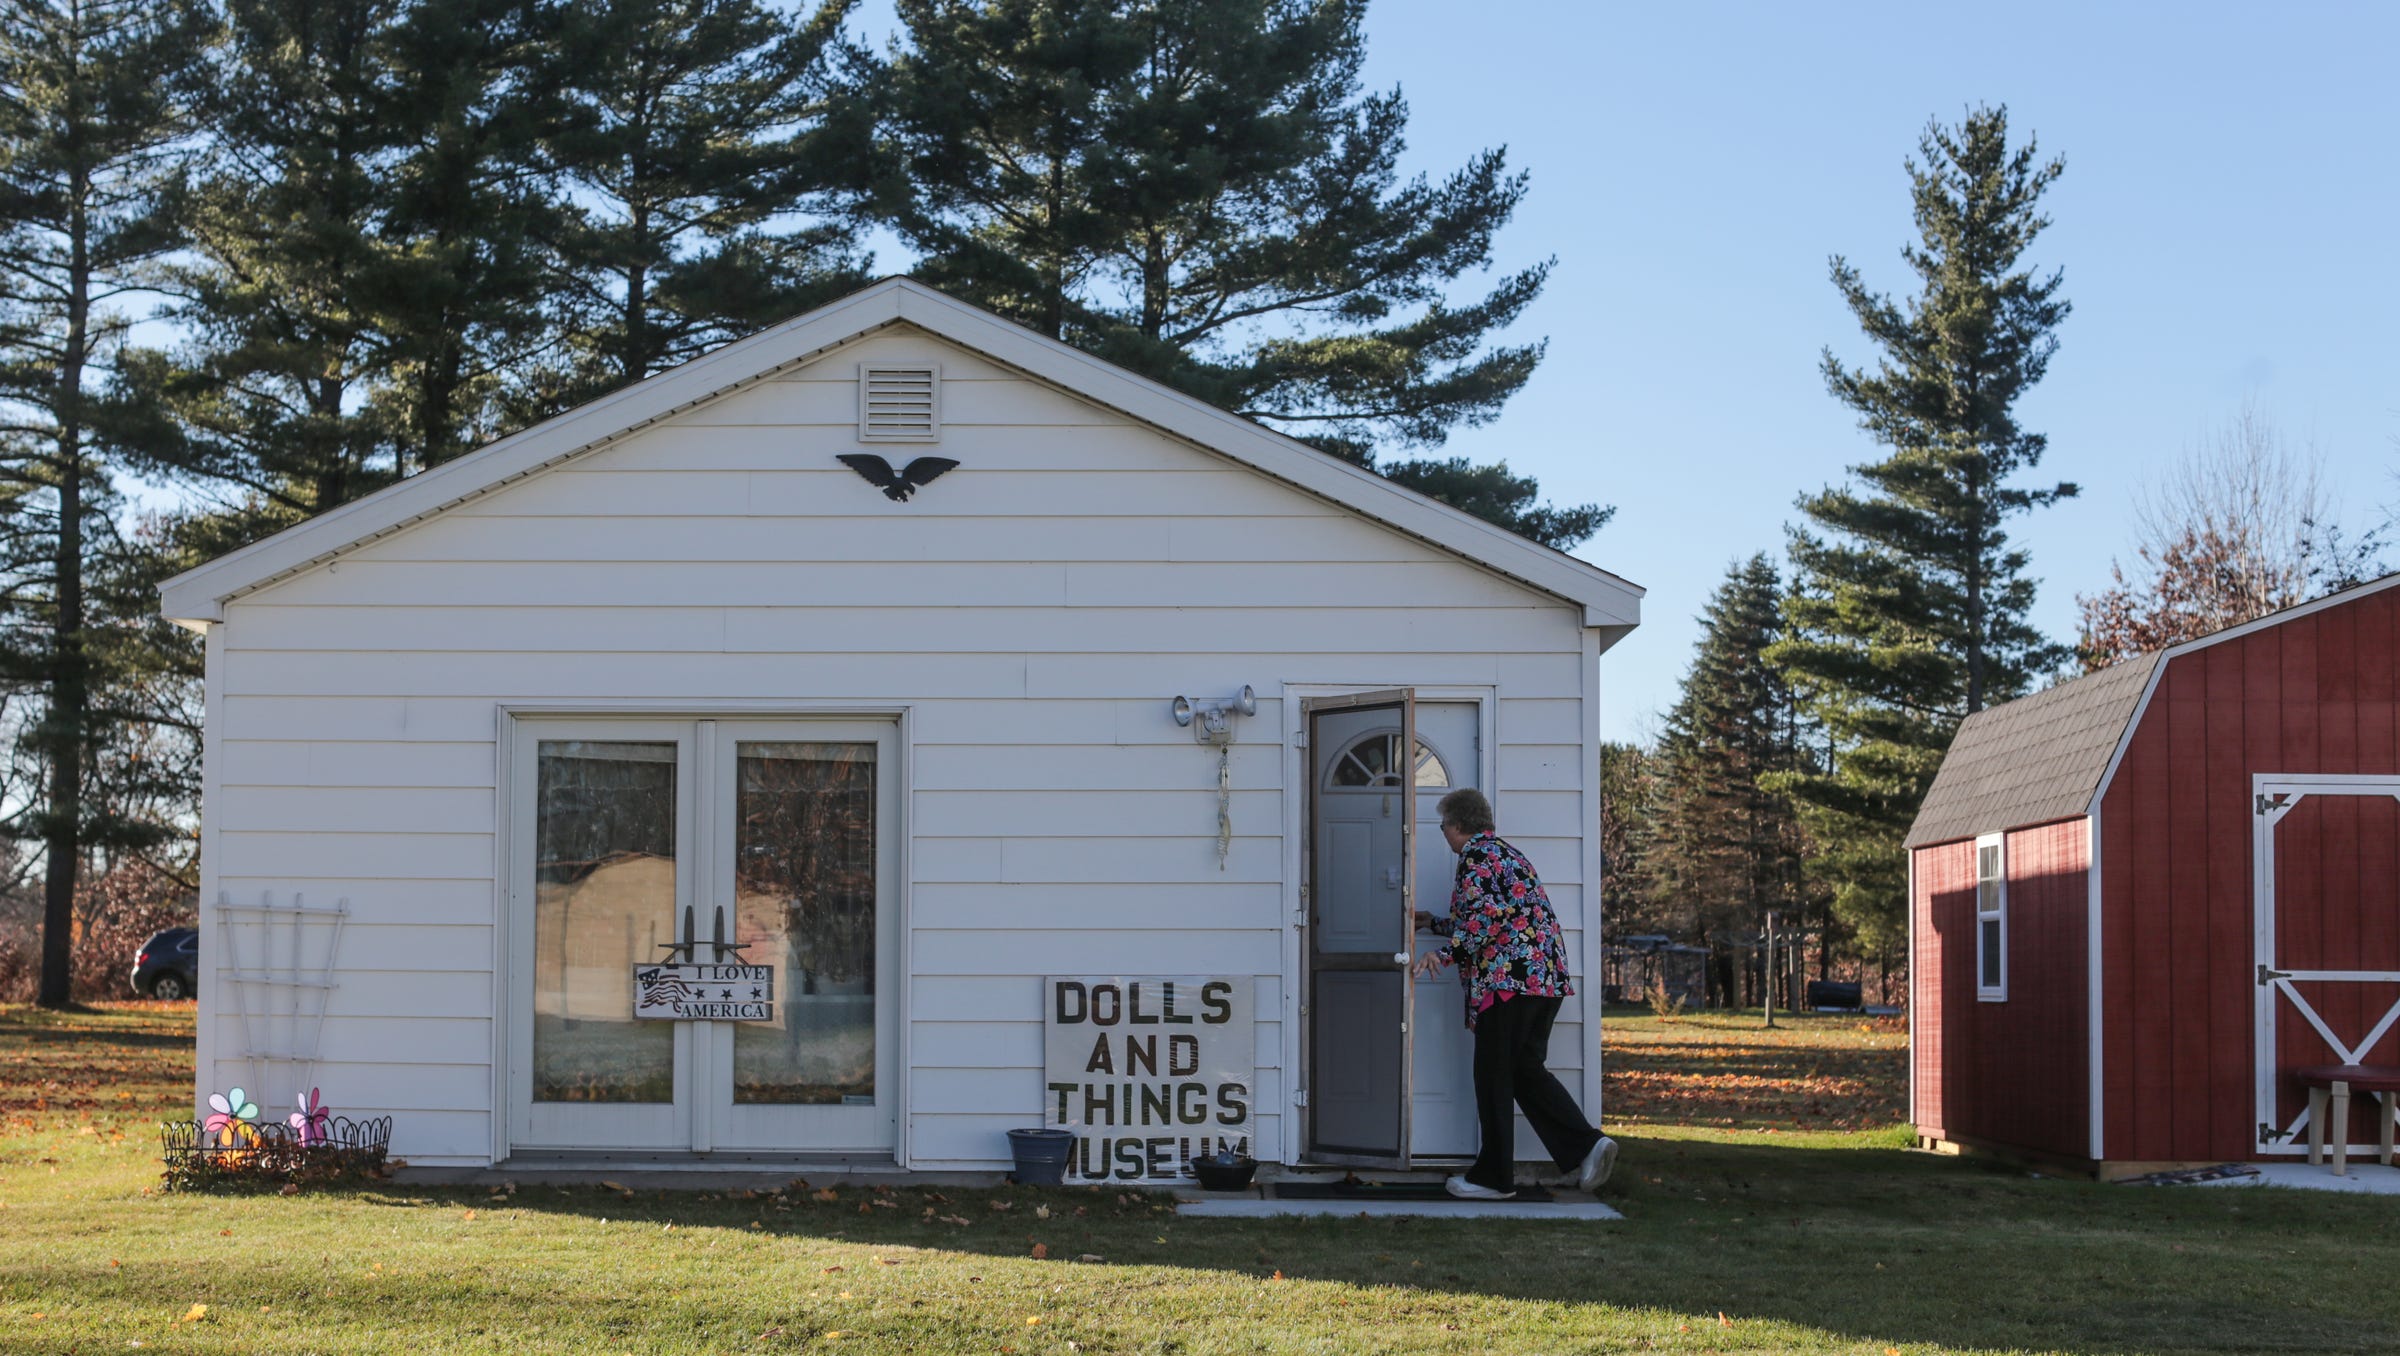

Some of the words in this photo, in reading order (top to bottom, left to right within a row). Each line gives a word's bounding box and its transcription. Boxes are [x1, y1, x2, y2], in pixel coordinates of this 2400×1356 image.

[696, 967, 703, 980] I
[713, 966, 765, 980] LOVE
[681, 1004, 765, 1018] AMERICA
[1056, 982, 1232, 1026] DOLLS
[1085, 1032, 1199, 1076] AND
[1048, 1082, 1247, 1126] THINGS
